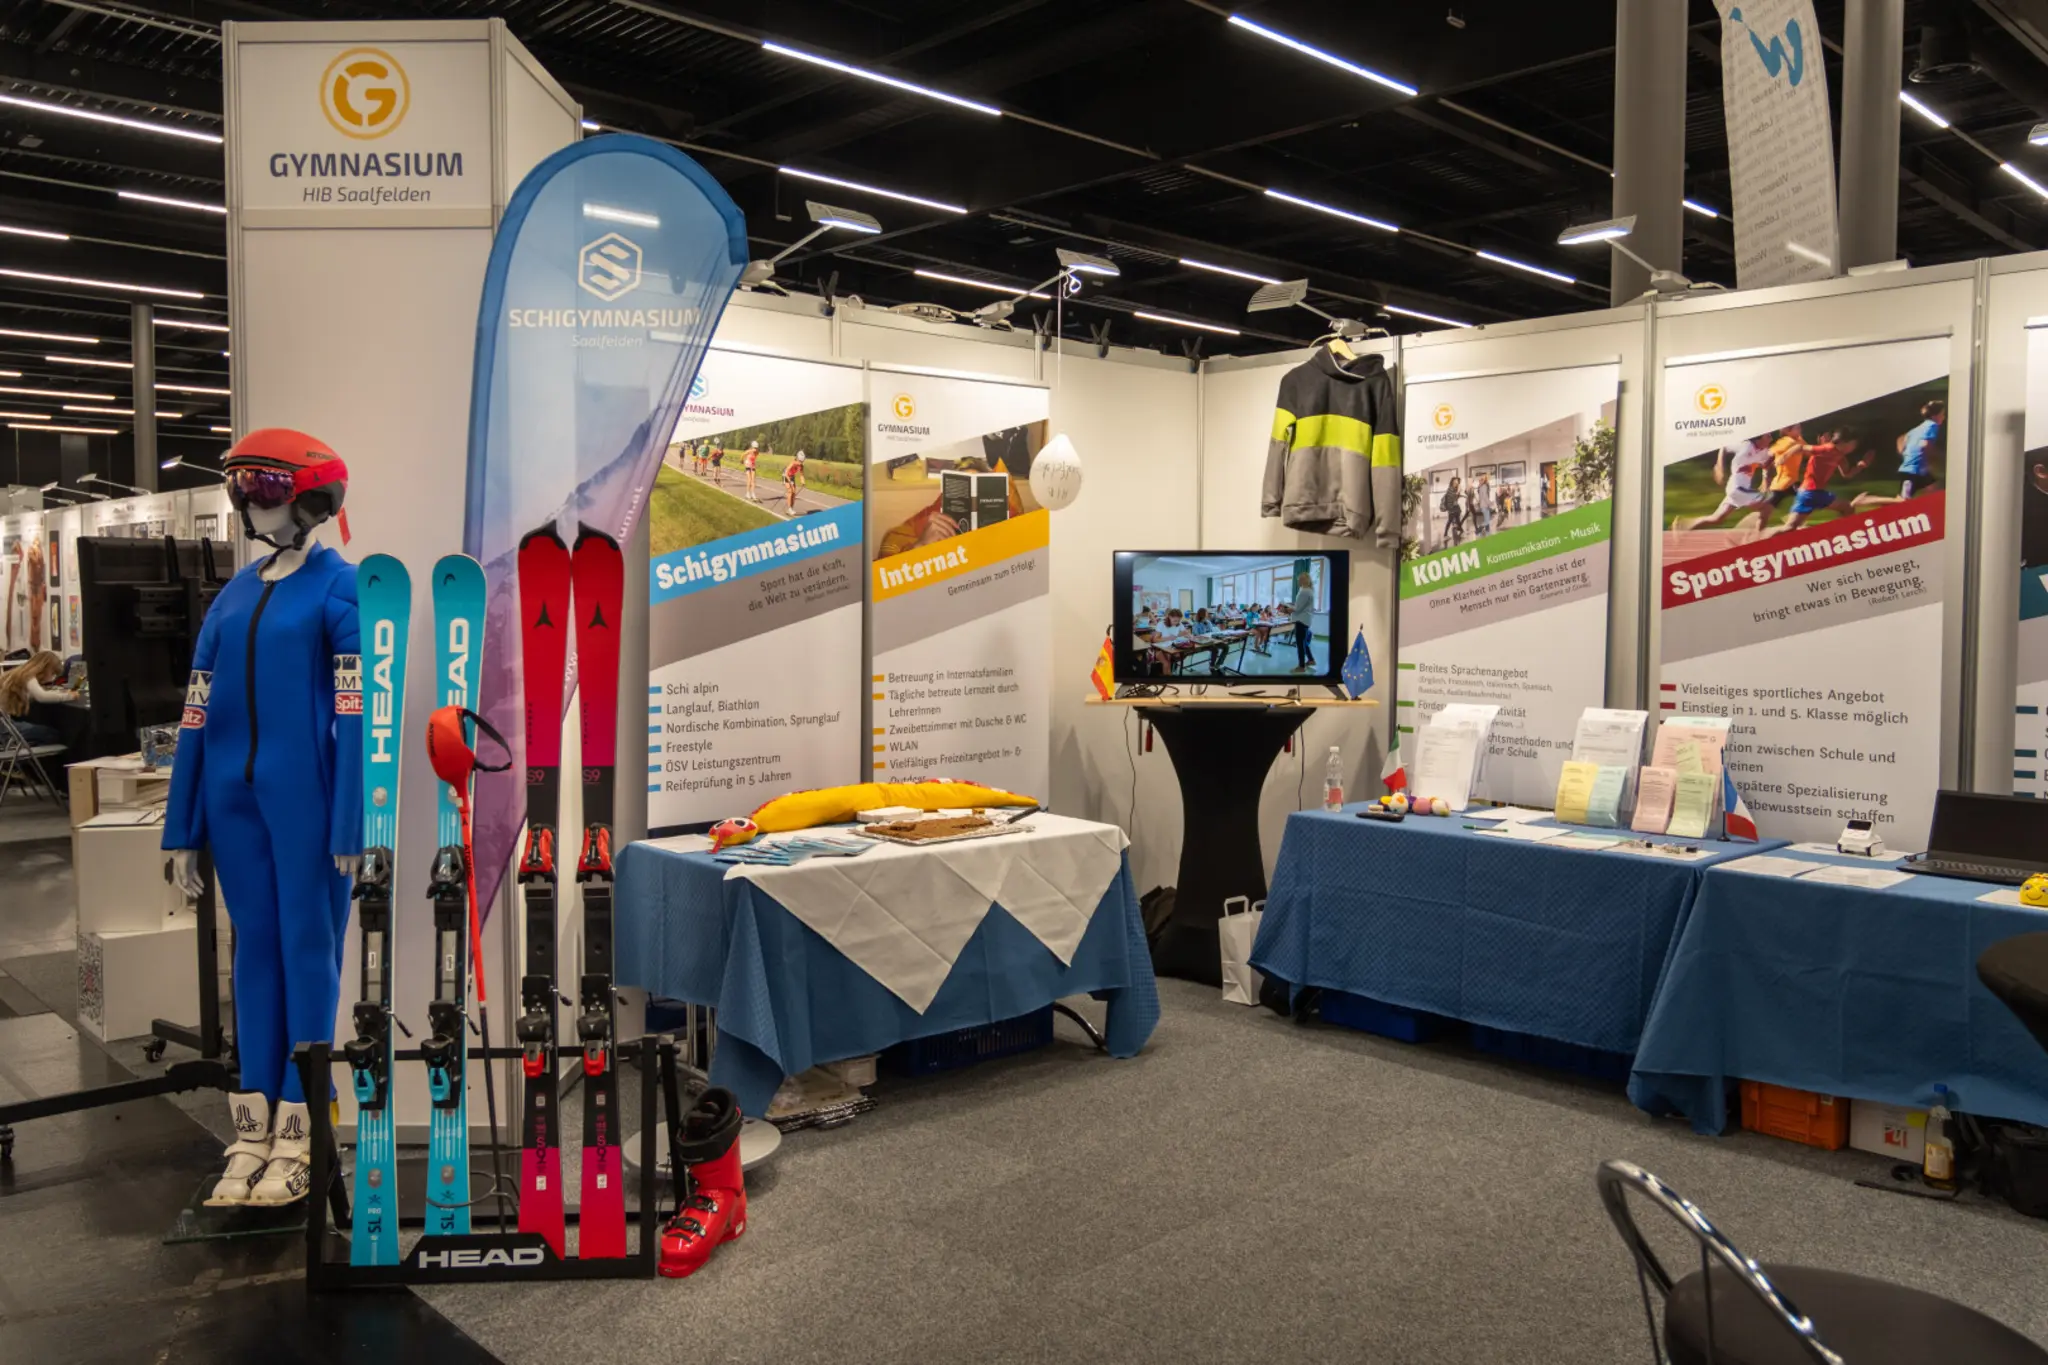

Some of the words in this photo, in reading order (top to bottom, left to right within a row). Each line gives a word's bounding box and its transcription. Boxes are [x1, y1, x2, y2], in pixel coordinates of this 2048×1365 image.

[270, 152, 463, 178] GYMNASIUM
[303, 187, 332, 202] HIB
[337, 186, 431, 205] Saalfelden
[509, 308, 700, 328] SCHIGYMNASIUM
[571, 335, 643, 349] Saalfelden
[685, 404, 735, 417] YMNASIUM
[878, 424, 930, 435] GYMNASIUM
[1675, 416, 1746, 430] GYMNASIUM
[1417, 432, 1469, 443] GYMNASIUM
[656, 522, 839, 589] Schigymnasium
[1412, 548, 1481, 586] KOMM
[1486, 536, 1561, 566] Kommunikation
[1570, 523, 1600, 541] Musik
[1670, 512, 1931, 600] Sportgymnasium
[760, 576, 786, 593] Sport
[788, 572, 804, 584] hat
[807, 567, 820, 577] die
[822, 558, 846, 571] Kraft,
[879, 545, 969, 589] Internat
[1807, 581, 1832, 593] Wer
[1836, 571, 1863, 586] sich
[1866, 559, 1920, 579] bewegt,
[947, 575, 992, 596] Gemeinsam
[994, 568, 1010, 580] zum
[1011, 559, 1036, 575] Erfolg!
[1429, 598, 1450, 610] Ohne
[1453, 587, 1486, 602] Klarheit
[1488, 584, 1497, 592] in
[1499, 579, 1514, 590] der
[1517, 568, 1553, 585] Sprache
[1556, 564, 1568, 573] ist
[1571, 557, 1586, 568] der
[748, 599, 763, 611] die
[765, 592, 787, 606] Welt
[790, 590, 800, 599] zu
[803, 574, 849, 594] verändern.
[1460, 597, 1493, 614] Mensch
[1495, 594, 1509, 604] nur
[1513, 589, 1526, 599] ein
[1528, 572, 1590, 595] Gartenzwerg.
[1753, 606, 1791, 623] bringt
[1794, 596, 1831, 613] etwas
[1835, 592, 1847, 604] in
[1851, 575, 1924, 600] Bewegung.
[888, 672, 934, 684] Betreuung
[936, 671, 944, 681] in
[947, 667, 1013, 680] Internatsfamilien
[1419, 663, 1448, 674] Breites
[1451, 664, 1528, 680] Sprachenangebot
[371, 619, 395, 762] HEAD
[667, 683, 689, 695] Schi
[693, 683, 719, 697] alpin
[889, 690, 925, 703] Tägliche
[928, 687, 962, 699] betreute
[964, 684, 995, 696] Lernzeit
[997, 683, 1019, 693] durch
[1681, 683, 1748, 699] Vielseitiges
[1752, 686, 1823, 702] sportliches
[1827, 689, 1885, 705] Angebot
[667, 703, 715, 717] Langlauf,
[718, 699, 760, 712] Biathlon
[1498, 707, 1526, 718] tivität
[1681, 701, 1728, 717] Einstieg
[1732, 703, 1744, 715] in
[1748, 706, 1757, 716] 1.
[1761, 706, 1786, 718] und
[1790, 709, 1801, 720] 5.
[1807, 707, 1848, 721] Klasse
[1853, 710, 1909, 726] möglich
[667, 721, 719, 734] Nordische
[723, 716, 787, 730] Kombination,
[790, 711, 841, 727] Sprunglauf
[889, 721, 957, 735] Zweibettzimmer
[960, 719, 973, 729] mit
[975, 717, 1003, 728] Dusche
[1006, 715, 1012, 725] &
[1014, 713, 1027, 724] WC
[666, 740, 713, 754] Freestyle
[889, 741, 919, 752] WLAN
[1487, 733, 1552, 748] chtsmethoden
[1555, 739, 1574, 751] und
[1489, 745, 1504, 755] der
[1507, 747, 1538, 759] Schule
[666, 759, 688, 772] ÖSV
[692, 753, 781, 771] Leistungszentrum
[889, 754, 938, 770] Vielfältiges
[940, 750, 1000, 765] Freizeitangebot
[1757, 744, 1815, 758] zwischen
[1819, 747, 1864, 762] Schule
[1869, 752, 1896, 764] und
[527, 769, 545, 782] S9
[582, 769, 600, 782] S9
[666, 774, 733, 792] Reifeprüfung
[736, 773, 746, 785] in
[749, 774, 755, 786] 5
[759, 770, 792, 783] Jahren
[1736, 780, 1782, 794] spätere
[1787, 783, 1888, 806] Spezialisierung
[1837, 808, 1895, 824] schaffen
[368, 1217, 382, 1233] SL
[441, 1213, 455, 1230] SL
[418, 1248, 545, 1269] HEAD
